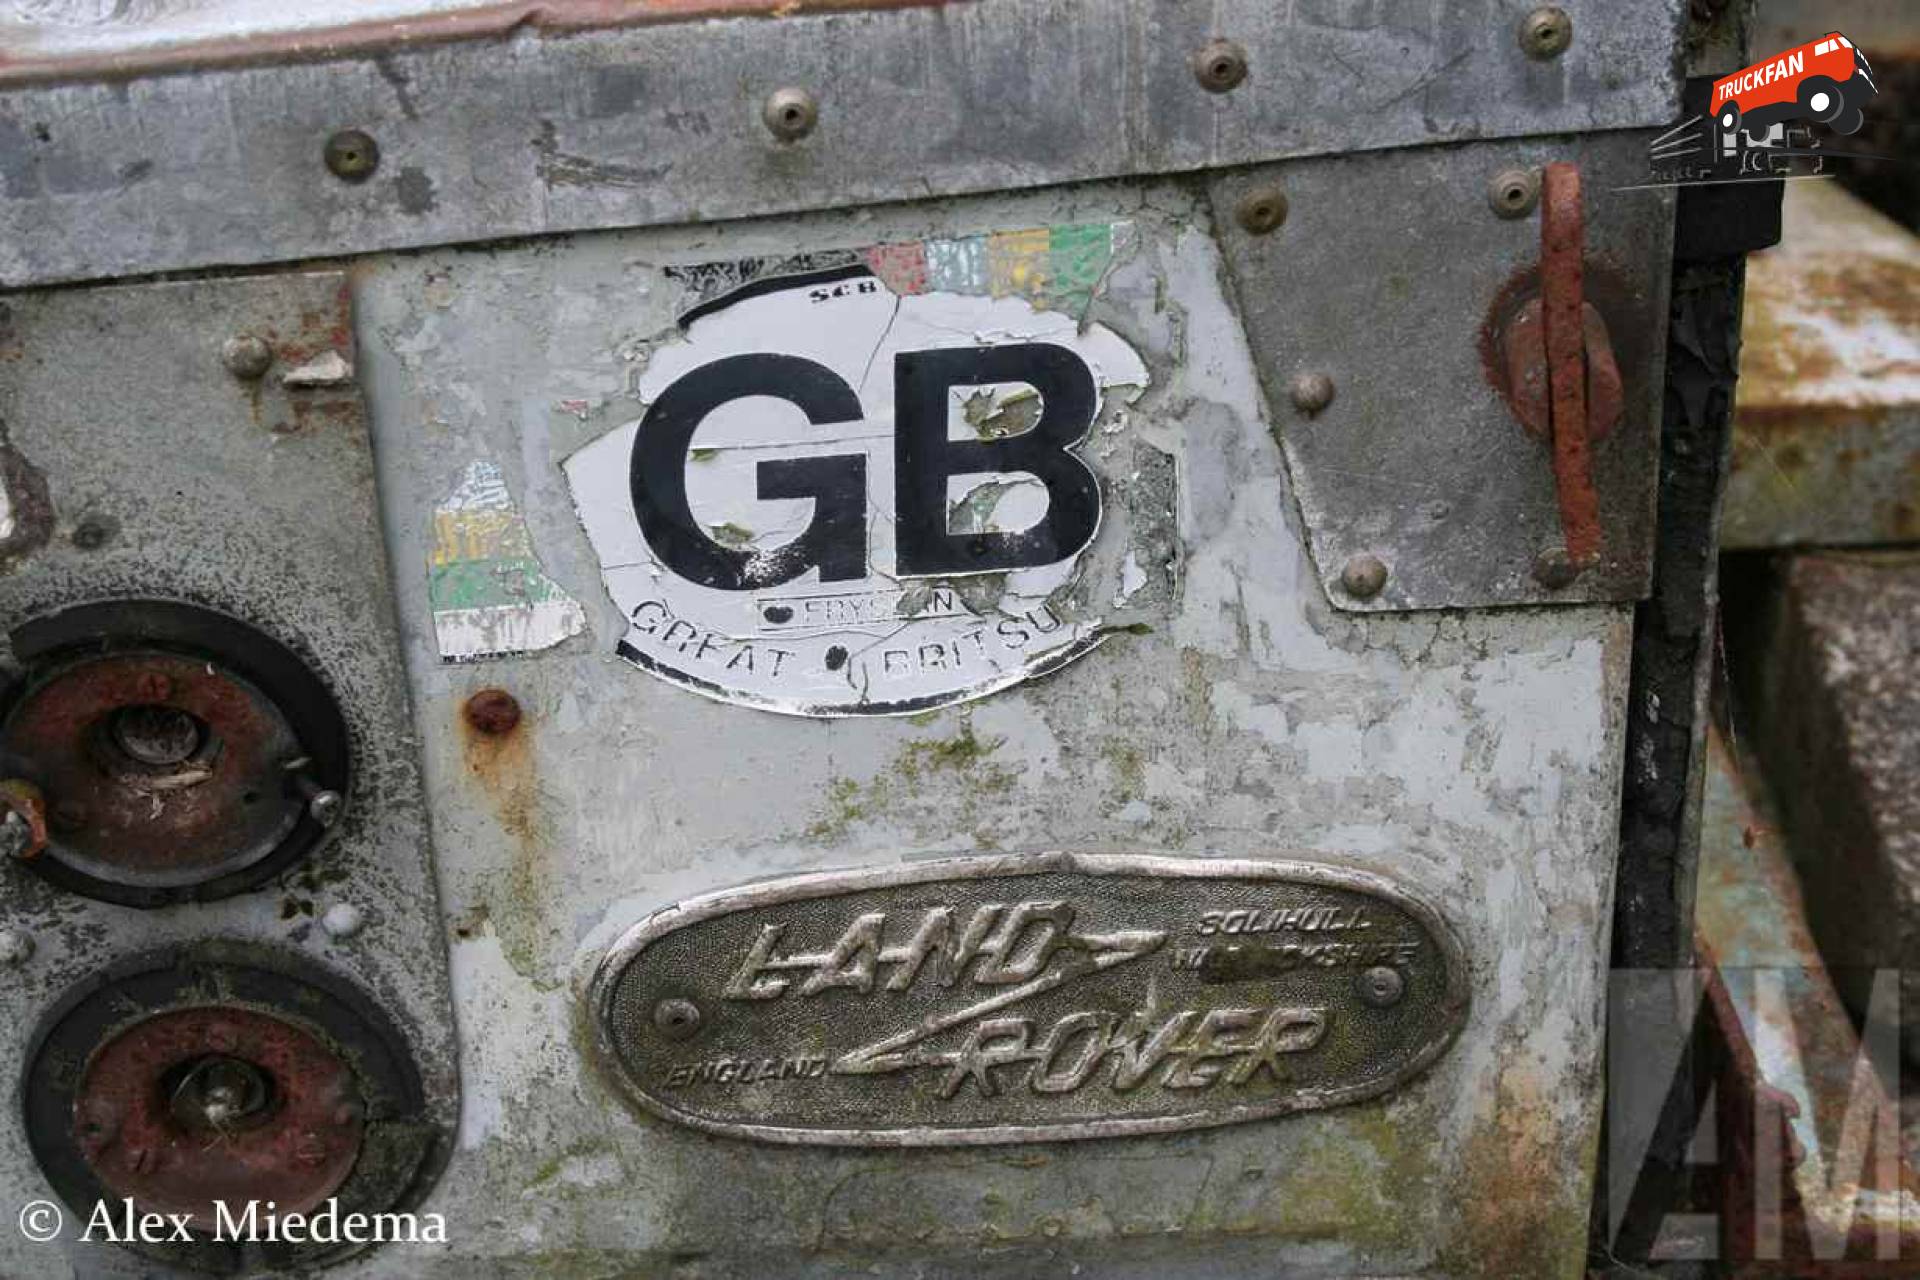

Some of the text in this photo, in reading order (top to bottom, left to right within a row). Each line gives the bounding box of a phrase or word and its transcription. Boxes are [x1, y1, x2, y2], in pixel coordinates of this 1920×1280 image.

[630, 342, 1102, 592] GB
[722, 900, 1076, 1000] LAND
[662, 1056, 826, 1090] ENGLAND
[937, 1007, 1328, 1100] ROVER
